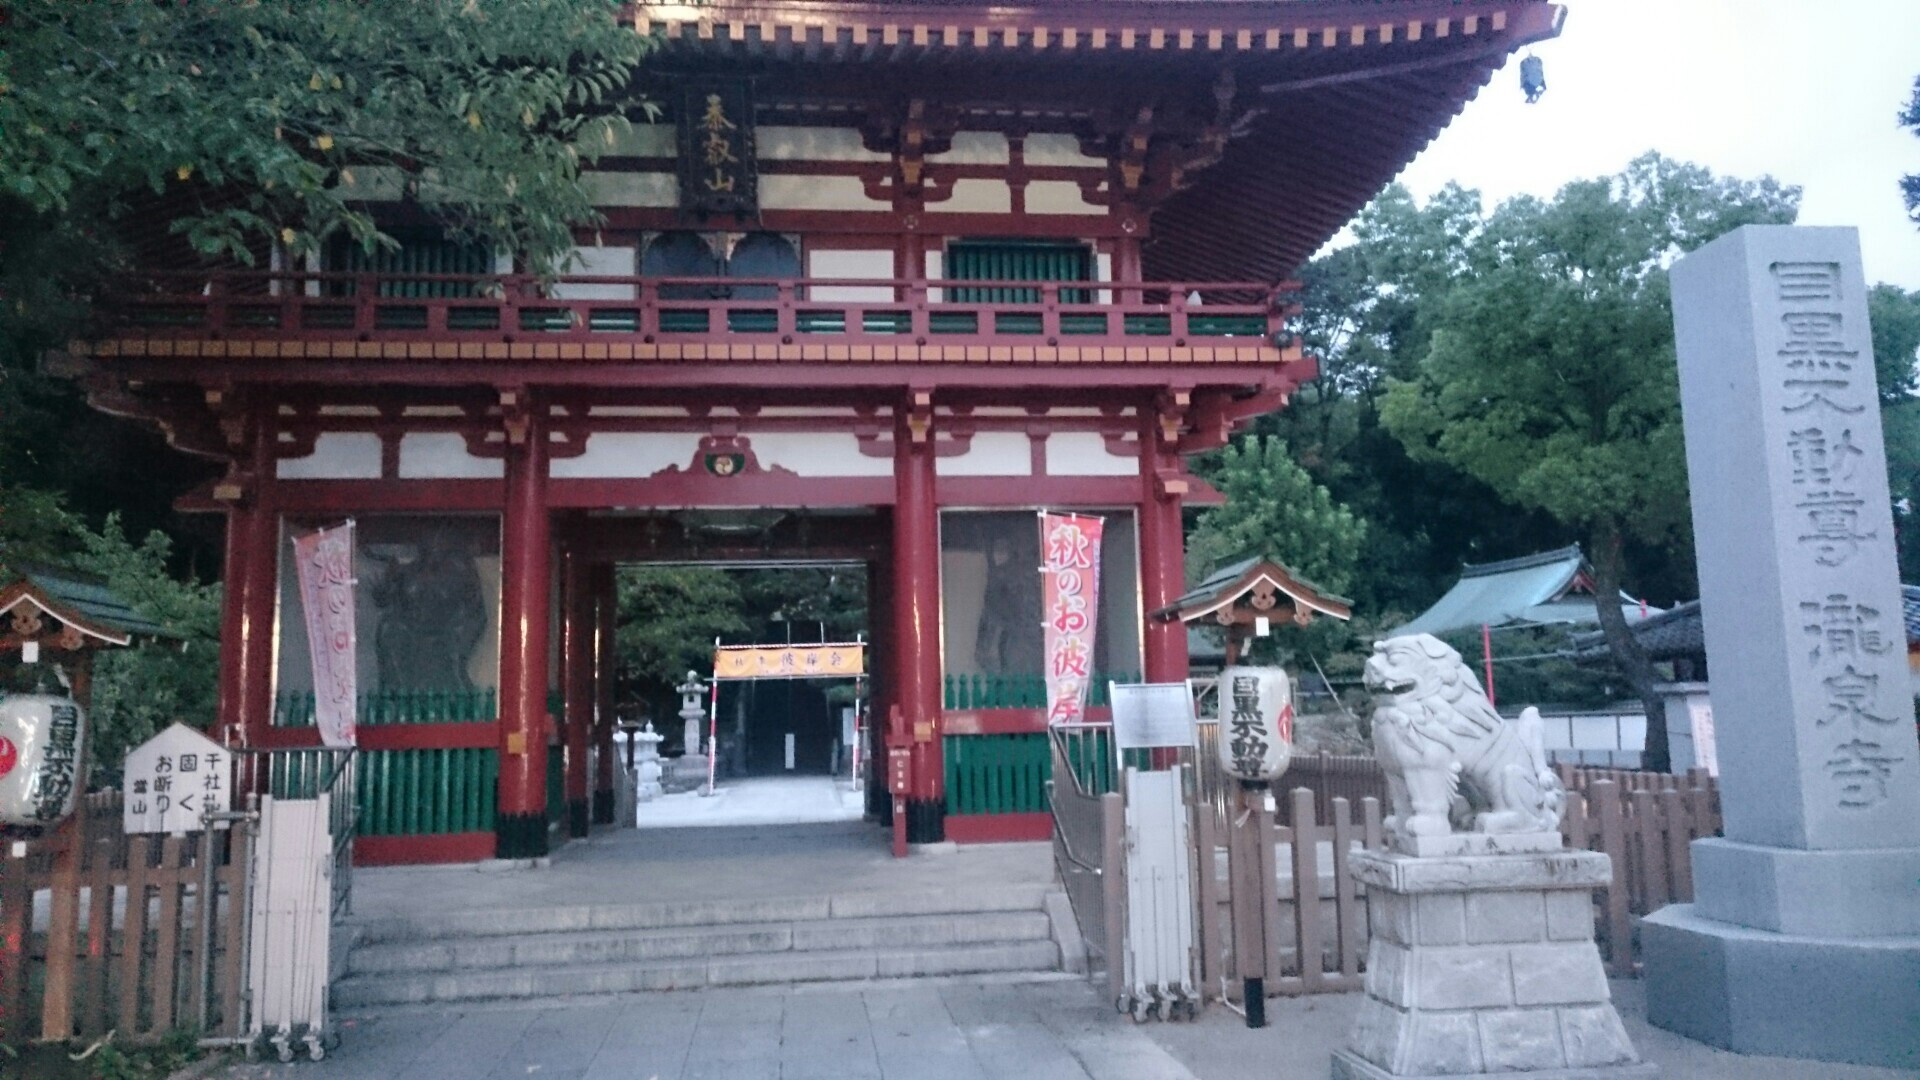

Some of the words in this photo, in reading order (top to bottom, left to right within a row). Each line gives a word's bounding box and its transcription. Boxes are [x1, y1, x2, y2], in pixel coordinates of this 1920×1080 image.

[1050, 523, 1091, 724] 秋のお彼岸
[1229, 675, 1269, 777] 目黒不動尊
[153, 755, 172, 814] お断り
[179, 753, 197, 812] 固く
